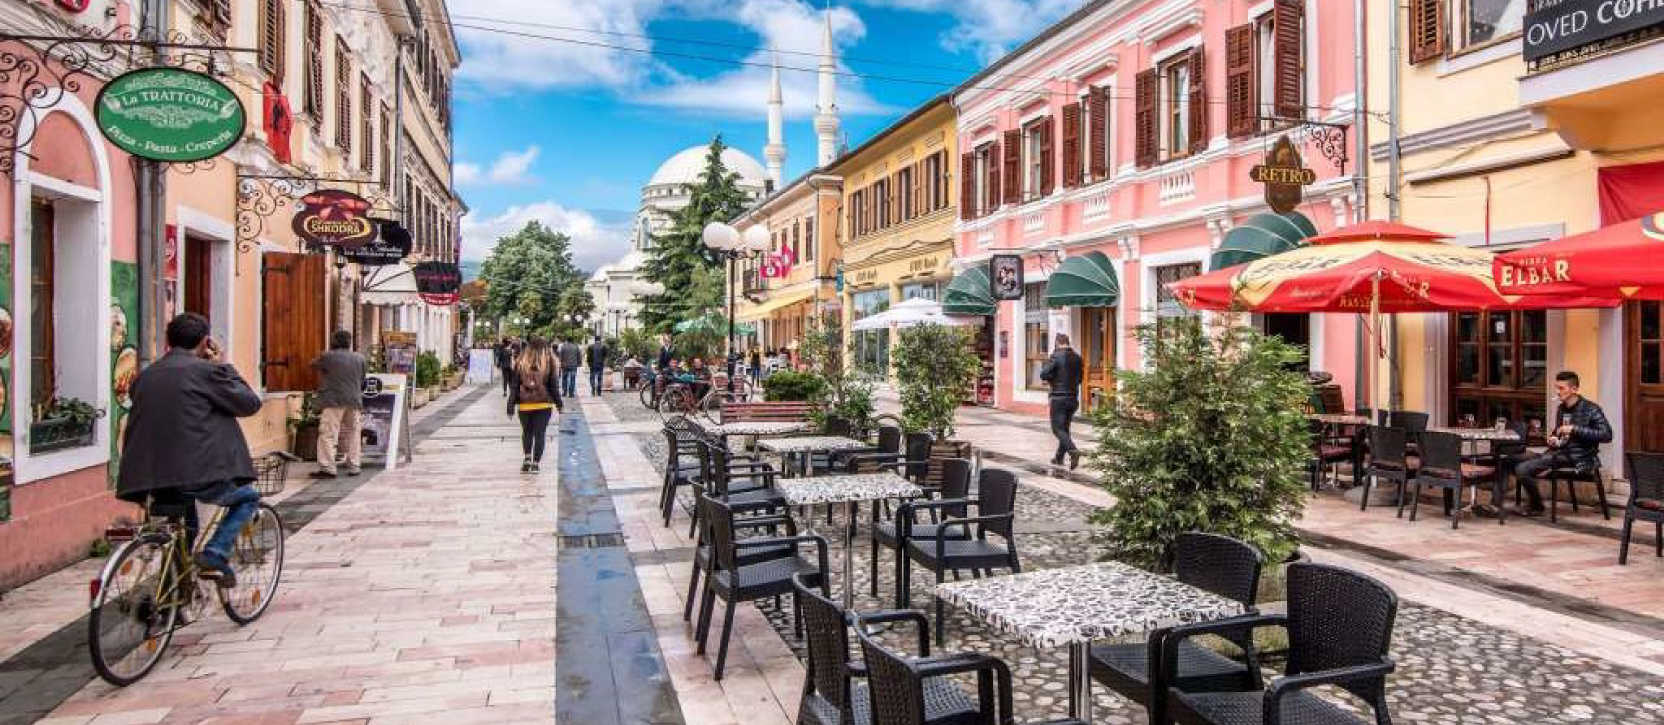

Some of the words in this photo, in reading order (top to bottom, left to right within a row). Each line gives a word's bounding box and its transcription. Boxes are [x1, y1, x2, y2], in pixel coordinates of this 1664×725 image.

[1527, 10, 1589, 46] OVED
[1597, 0, 1664, 24] COH
[121, 95, 138, 106] La
[141, 90, 220, 111] TRATTORIA
[145, 141, 177, 153] Pasta
[1259, 166, 1312, 184] RETRO
[311, 223, 360, 234] SHKODRA
[1500, 260, 1571, 287] ELBAR
